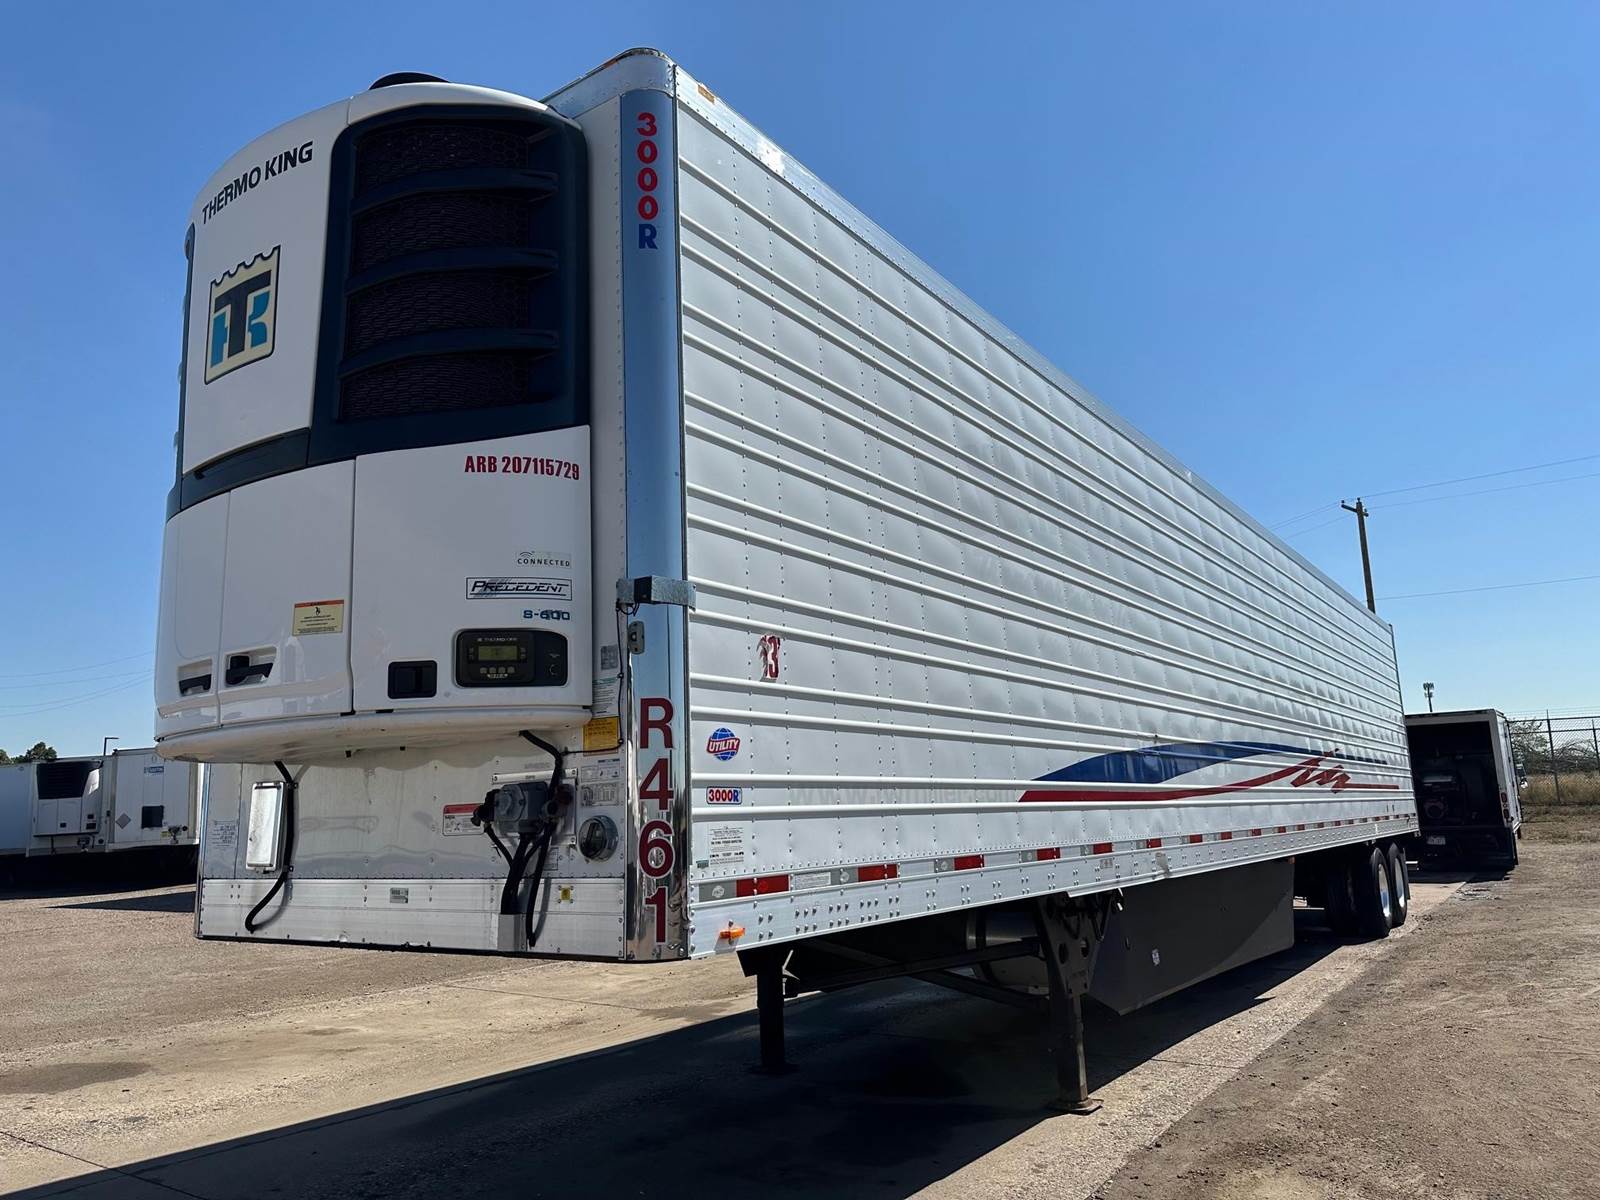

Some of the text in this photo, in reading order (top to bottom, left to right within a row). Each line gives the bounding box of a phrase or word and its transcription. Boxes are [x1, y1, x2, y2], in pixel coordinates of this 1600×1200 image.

[202, 140, 313, 225] THERMO KING
[636, 112, 658, 250] 3000R
[464, 455, 580, 481] ARB 207115729
[517, 558, 570, 567] CONNECTED
[471, 580, 569, 593] PRECEDENT
[708, 738, 740, 752] UTILITY
[708, 788, 740, 802] 3000R
[639, 697, 674, 943] R461
